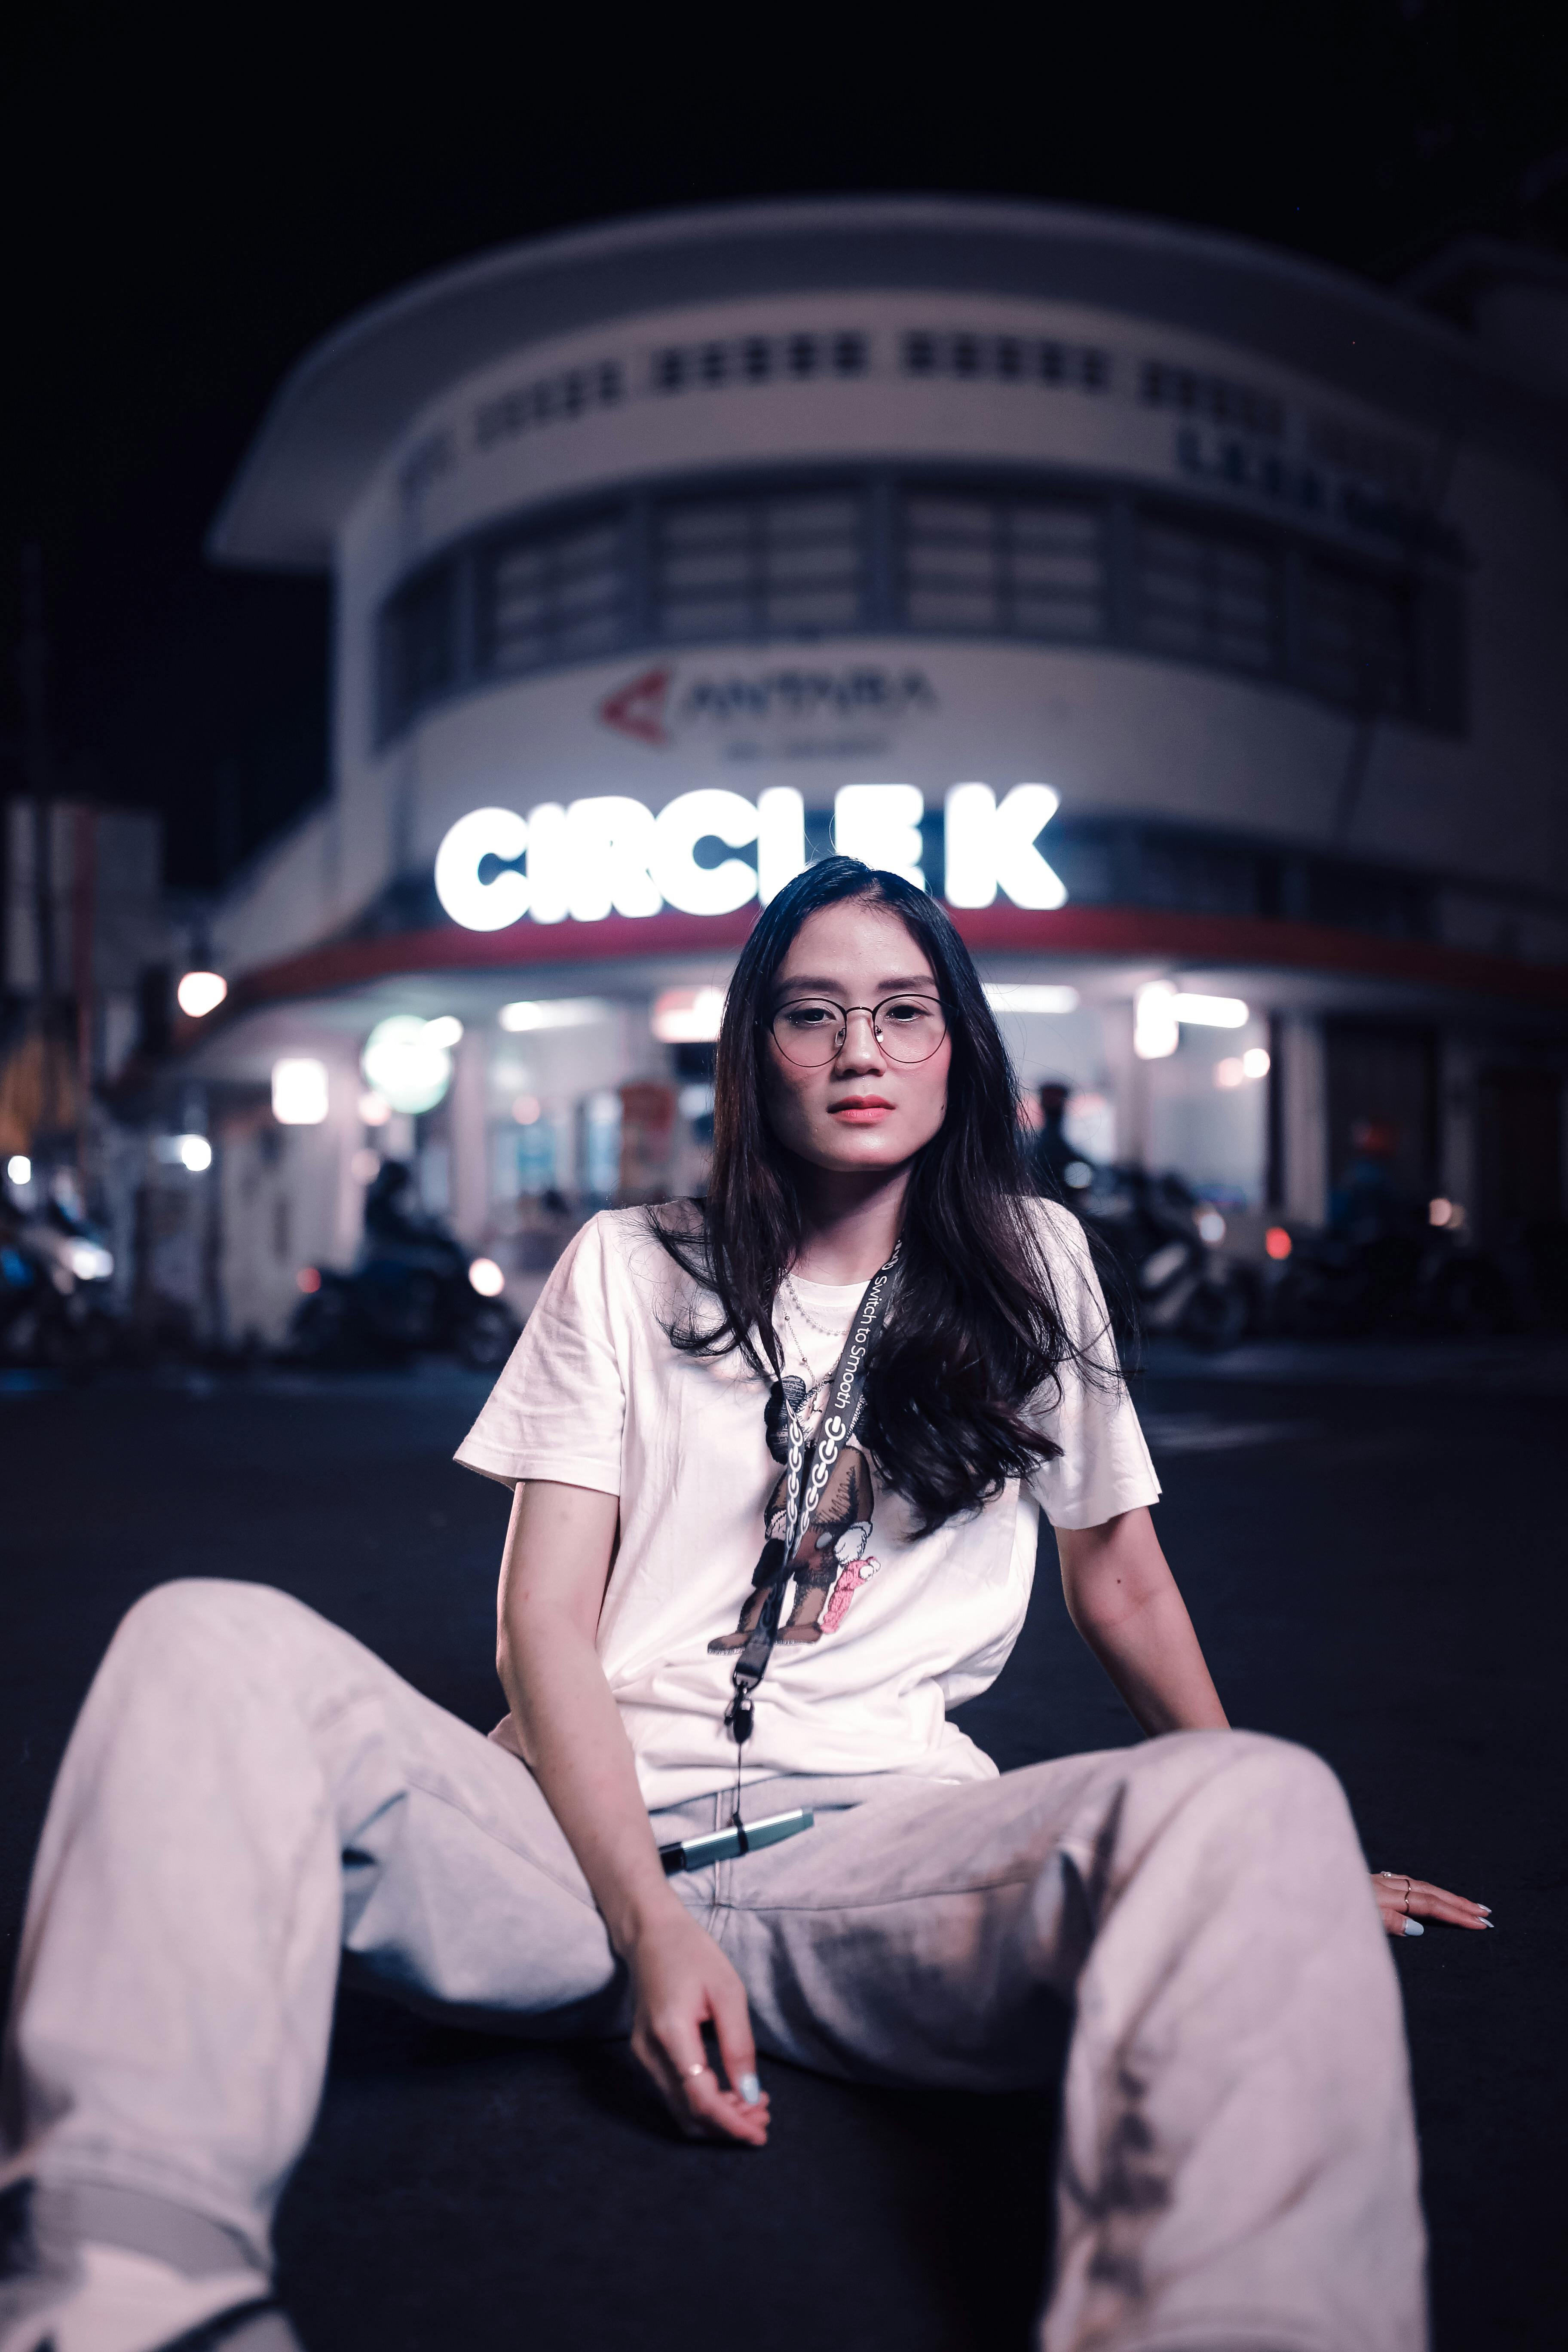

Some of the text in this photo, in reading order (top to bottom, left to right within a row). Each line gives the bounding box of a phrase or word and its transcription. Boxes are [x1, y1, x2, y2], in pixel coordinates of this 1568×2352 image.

[945, 782, 1068, 910] K
[834, 1276, 888, 1409] Switch to Smooth
